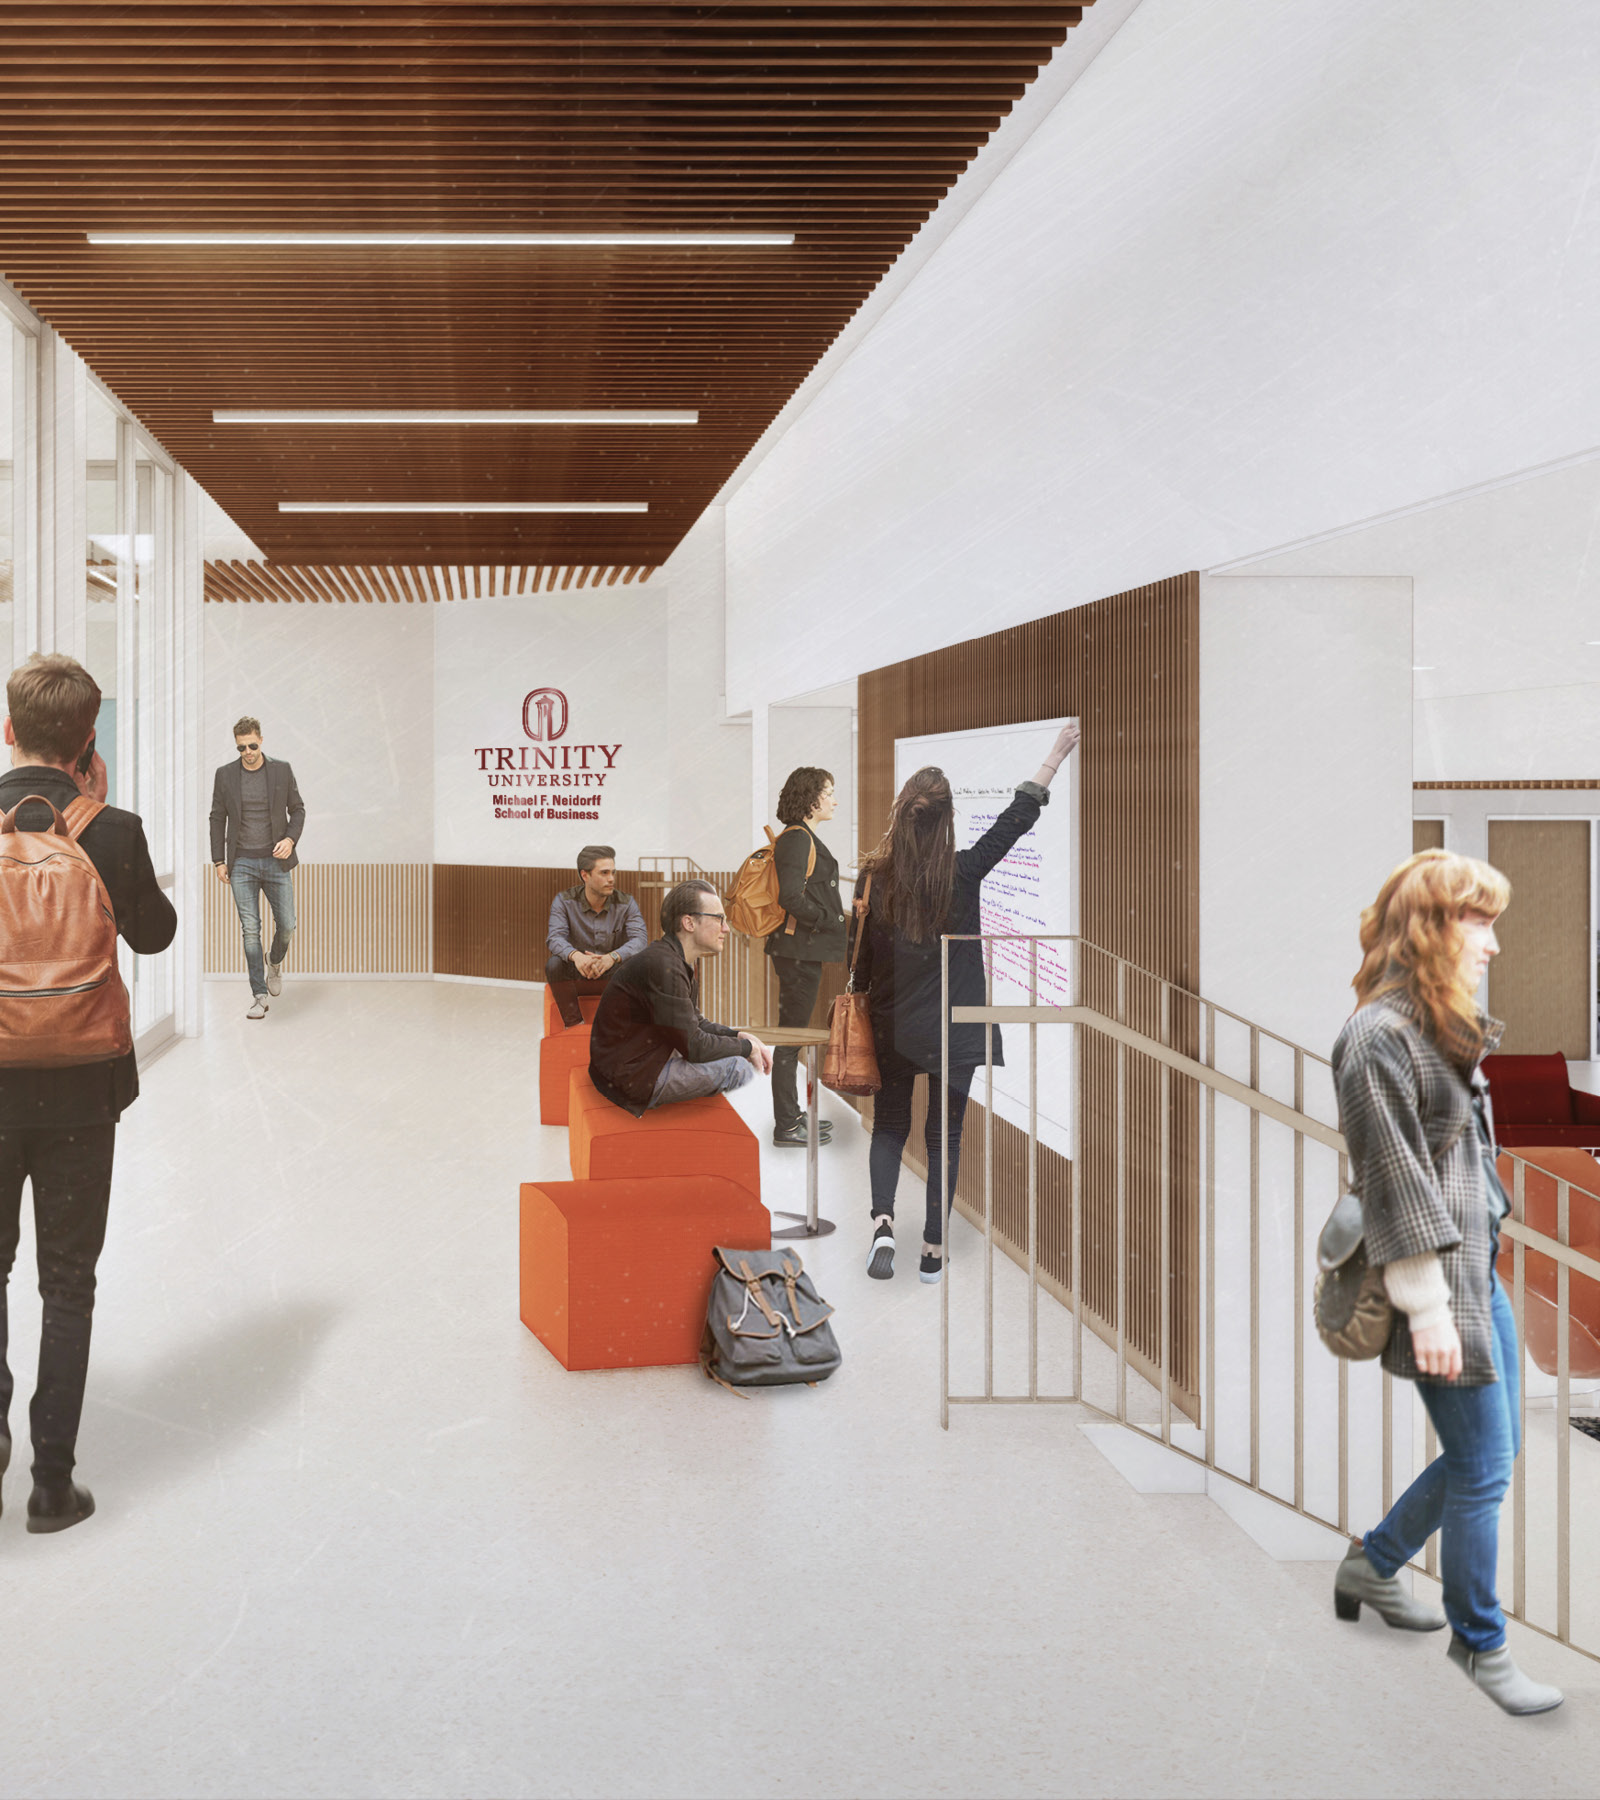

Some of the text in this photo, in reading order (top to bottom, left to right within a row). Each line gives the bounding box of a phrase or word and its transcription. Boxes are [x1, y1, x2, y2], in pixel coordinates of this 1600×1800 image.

[474, 744, 623, 771] TRINITY
[487, 773, 607, 787] UNIVERSITY
[492, 794, 602, 806] Michael F. Neidorff
[494, 808, 599, 820] School of Business
